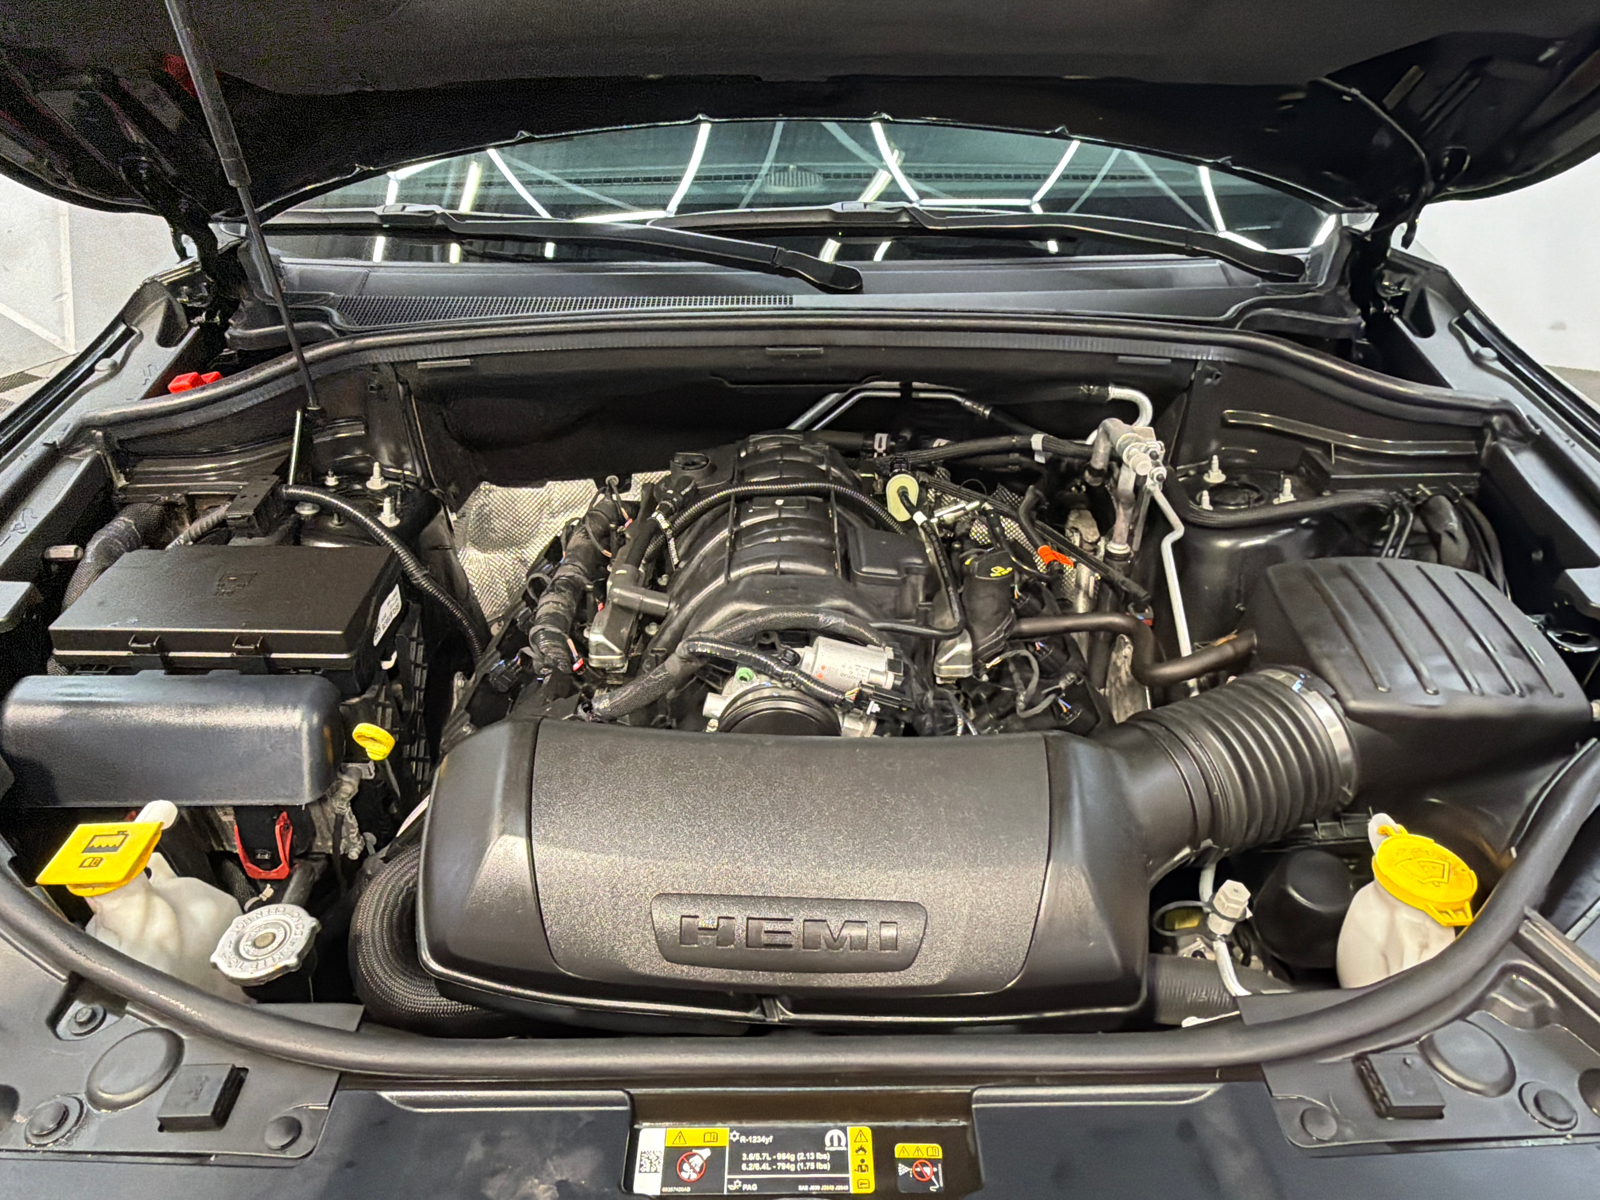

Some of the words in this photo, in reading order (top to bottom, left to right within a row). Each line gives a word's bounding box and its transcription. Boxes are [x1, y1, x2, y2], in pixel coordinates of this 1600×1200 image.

[255, 907, 286, 919] OPEN
[232, 916, 252, 935] HOT
[679, 914, 899, 952] HEMI
[251, 951, 284, 972] KEEP
[739, 1135, 774, 1145] R-1234yf
[796, 1152, 815, 1161] (2.13
[816, 1152, 830, 1161] lbs)
[776, 1162, 796, 1172] 794g
[796, 1162, 815, 1171] (1.75
[816, 1162, 830, 1171] lbs)
[742, 1183, 758, 1191] PAG
